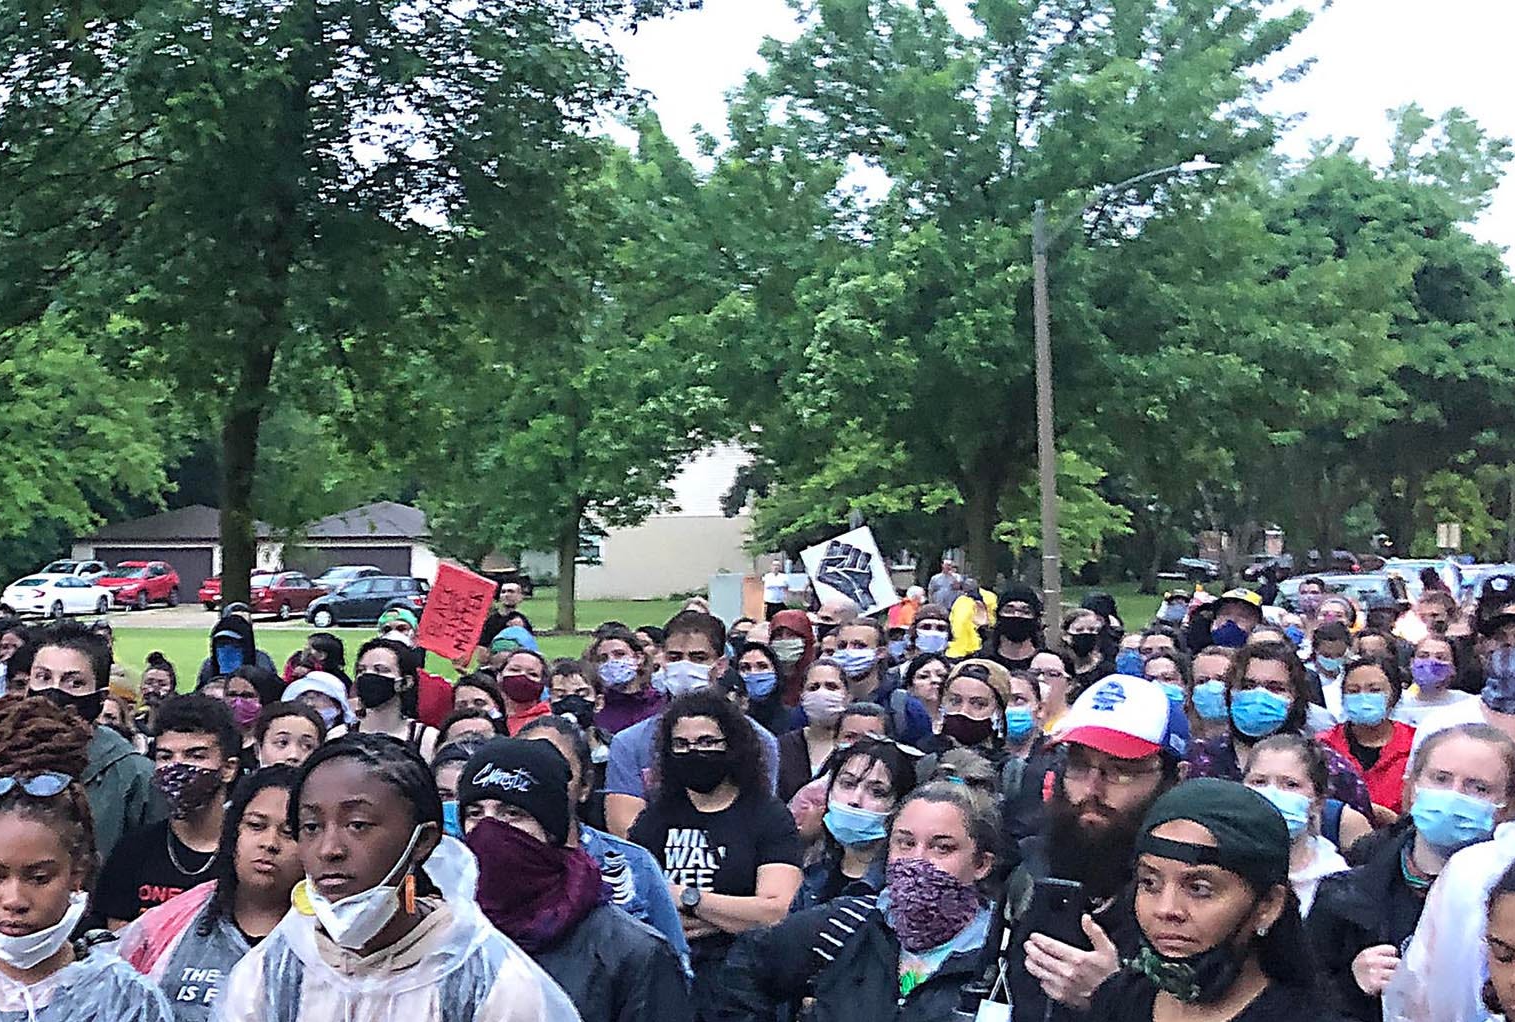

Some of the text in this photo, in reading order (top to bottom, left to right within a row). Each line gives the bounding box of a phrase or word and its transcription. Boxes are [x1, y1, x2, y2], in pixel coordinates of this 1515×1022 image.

[452, 593, 485, 653] MATTER
[180, 966, 222, 983] THE
[176, 985, 200, 1002] IS
